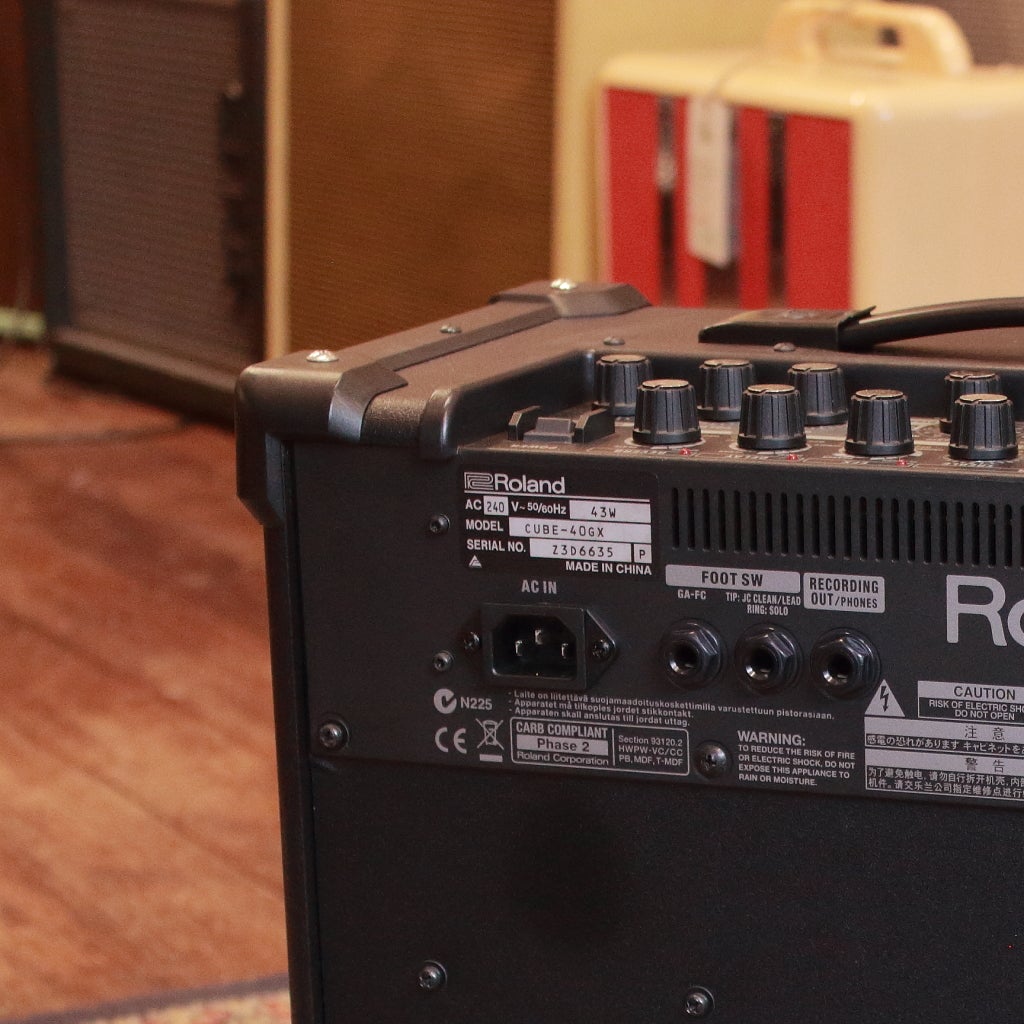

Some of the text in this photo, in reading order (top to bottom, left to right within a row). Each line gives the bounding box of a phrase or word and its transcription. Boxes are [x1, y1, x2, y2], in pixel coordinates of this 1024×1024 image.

[494, 473, 565, 494] Roland
[465, 499, 482, 511] AC
[486, 501, 505, 513] 240
[527, 502, 567, 515] 50/60Hz
[591, 506, 616, 518] 43W
[465, 519, 604, 538] MODEL CUBE-40GX
[467, 539, 646, 559] SERIAL NO. Z3D6635 P
[565, 561, 652, 575] MADE IN CHINA
[701, 570, 763, 587] FOOT SW
[809, 577, 879, 594] RECORDING
[521, 579, 557, 594] AC IN
[677, 590, 707, 601] GA-FC
[725, 591, 801, 606] TIP: JC CLEAN/LEAD
[747, 603, 789, 616] RING: SOLO
[953, 685, 1016, 701] CAUTION
[460, 696, 493, 711] N225
[718, 705, 775, 717] varustettuun
[928, 699, 950, 709] RISK
[951, 700, 963, 710] OF
[965, 701, 1008, 712] ELECTRIC
[954, 709, 1015, 721] DO NOT OPEN
[516, 721, 608, 739] CARB COMPLIANT
[536, 737, 590, 752] Phase 2
[618, 734, 683, 747] Section 93120.2
[737, 730, 806, 746] WARNING:
[516, 750, 609, 766] Roland Corporation
[618, 745, 683, 757] HWPW-VC/CC
[738, 745, 855, 759] TO REDUCE THE RISK OF FIRE
[738, 754, 750, 762] OR
[751, 755, 791, 765] ELECTRIC
[825, 760, 837, 768] DO
[838, 761, 855, 769] NOT
[738, 764, 849, 778] EXPOSE THIS APPLIANCE TO
[738, 773, 818, 786] RAIN OR MOISTURE.
